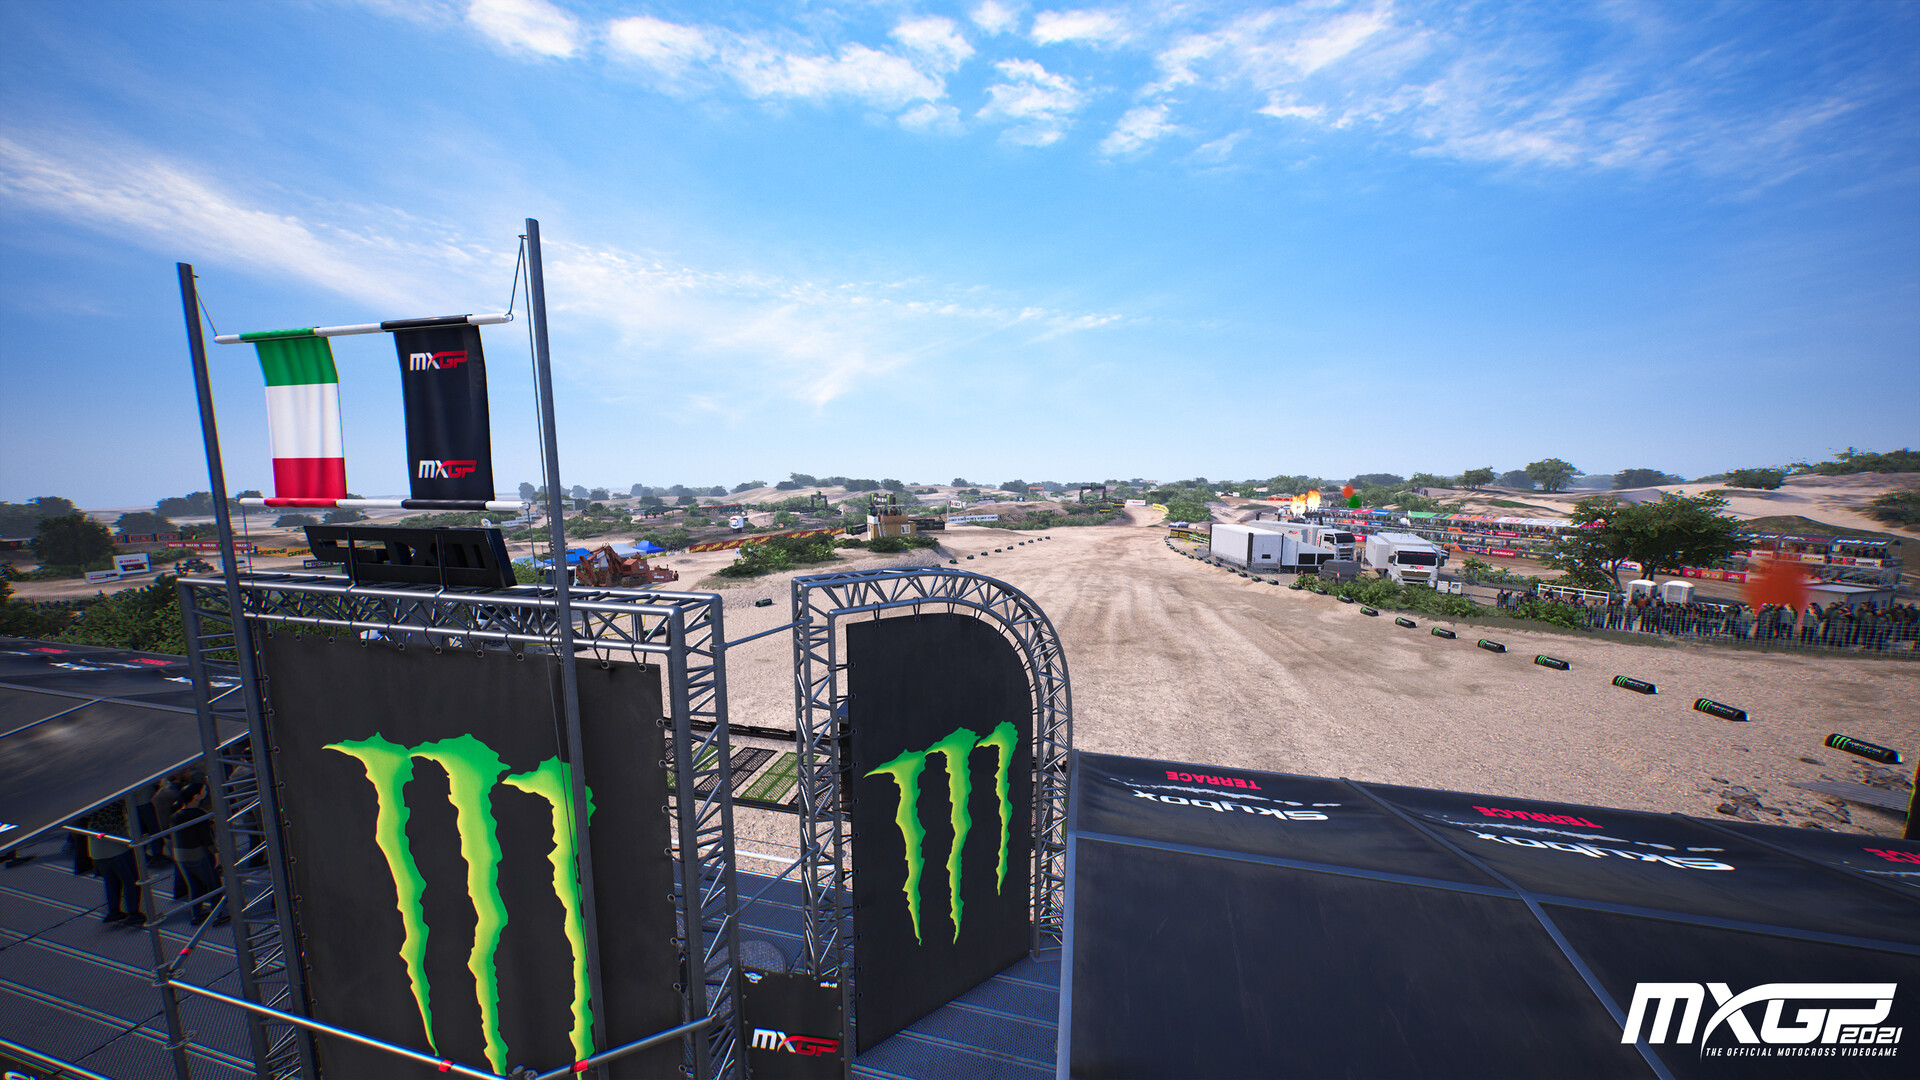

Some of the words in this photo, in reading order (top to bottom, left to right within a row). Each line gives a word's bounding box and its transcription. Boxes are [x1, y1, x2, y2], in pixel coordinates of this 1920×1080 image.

[409, 350, 468, 372] MXGP
[418, 460, 477, 480] MXGP
[1165, 770, 1262, 790] TERRACE
[1132, 789, 1329, 821] Skybox
[1472, 805, 1604, 829] TERRACE
[1465, 829, 1735, 871] Skybox
[751, 1026, 839, 1057] MXGP
